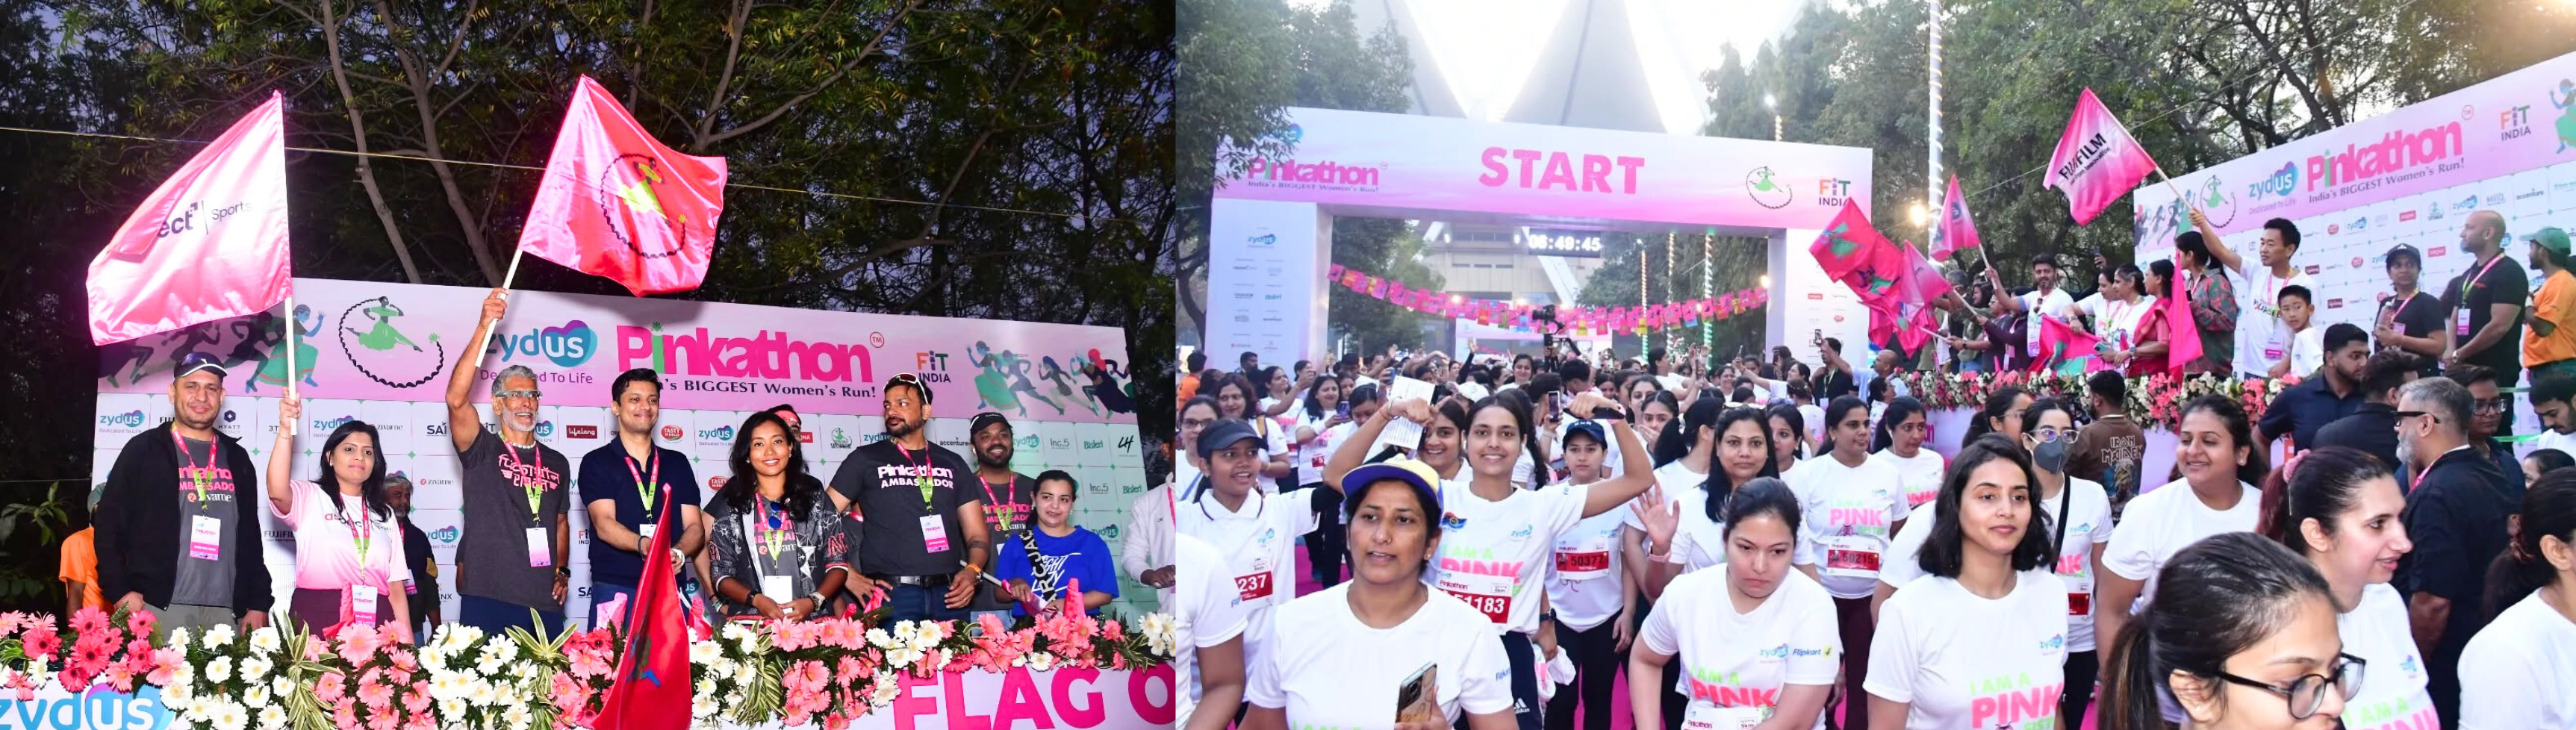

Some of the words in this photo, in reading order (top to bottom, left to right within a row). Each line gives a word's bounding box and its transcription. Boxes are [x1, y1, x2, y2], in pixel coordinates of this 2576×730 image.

[2501, 126, 2531, 141] INDIA
[2307, 121, 2463, 192] Pinkathon
[1248, 157, 1379, 185] Pinkathon
[1478, 146, 1645, 194] START
[2249, 172, 2292, 200] zydus
[2309, 189, 2337, 203] India's
[2340, 180, 2382, 196] BIGGEST
[2386, 166, 2435, 185] Women's
[2438, 157, 2465, 172] Run!
[211, 202, 252, 222] Sports
[871, 336, 883, 344] TM
[616, 322, 874, 383] Pinkathon
[550, 372, 565, 383] To
[569, 372, 593, 384] Life
[918, 372, 951, 384] INDIA
[684, 379, 756, 393] BIGGEST
[763, 384, 837, 396] Women's
[842, 385, 877, 398] Run!
[99, 412, 140, 426] zydus
[568, 427, 596, 437] lifelong
[698, 428, 730, 440] zydus
[1050, 438, 1070, 447] Inc.5
[2110, 435, 2135, 448] IRON
[1089, 483, 1109, 493] Inc.5
[1830, 508, 1885, 527] PINK
[1452, 546, 1478, 558] AM
[1482, 547, 1493, 559] A
[1842, 553, 1875, 564] 50215
[1440, 580, 1468, 590] Pinkathon
[1759, 647, 1788, 658] zydus
[1792, 648, 1821, 657] Flipkart
[1696, 667, 1723, 683] AM
[1728, 671, 1740, 685] A
[1970, 679, 1976, 696] I
[1982, 674, 2013, 693] AM
[2018, 671, 2032, 687] A
[893, 666, 1106, 730] FLAG
[1691, 677, 1778, 708] PINK
[1971, 682, 2065, 729] PINK
